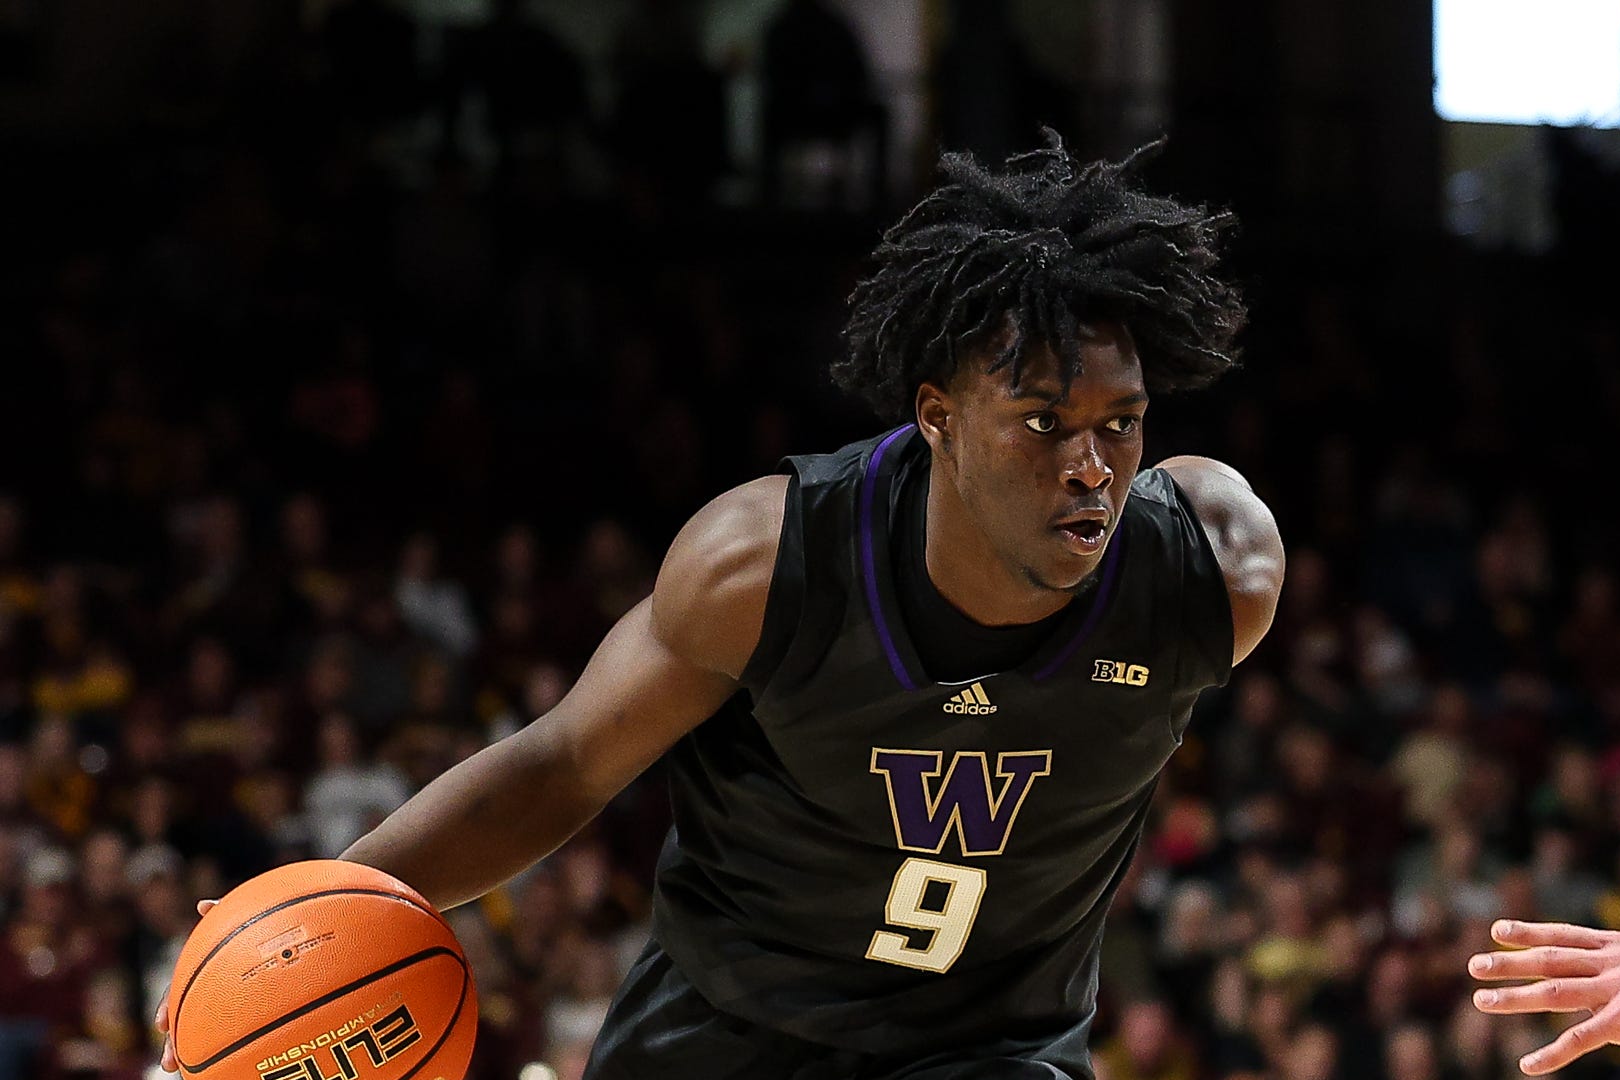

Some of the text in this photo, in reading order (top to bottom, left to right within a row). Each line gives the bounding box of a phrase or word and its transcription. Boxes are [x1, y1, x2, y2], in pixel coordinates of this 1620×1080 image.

[943, 702, 998, 715] adidas
[869, 747, 1053, 857] W
[865, 857, 988, 974] 9
[256, 992, 403, 1071] AMPIONSHIP
